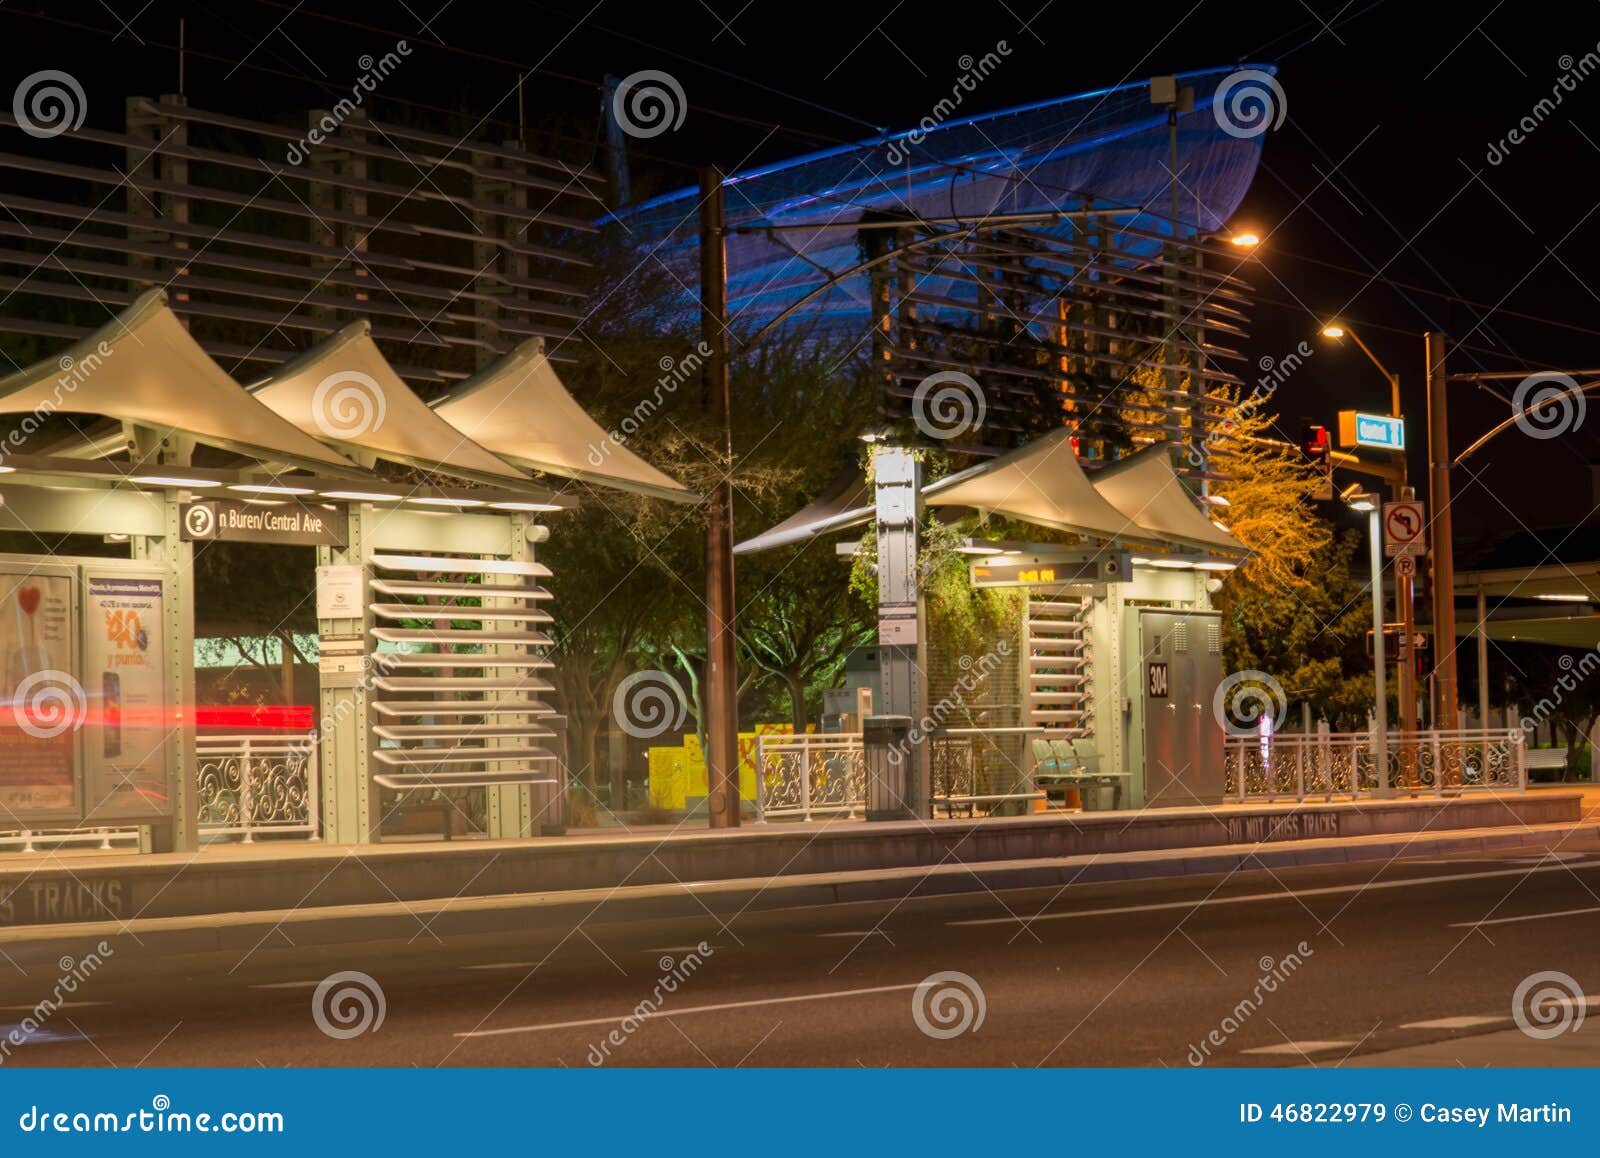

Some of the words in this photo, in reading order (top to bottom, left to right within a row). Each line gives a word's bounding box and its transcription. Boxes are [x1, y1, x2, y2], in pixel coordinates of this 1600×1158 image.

[229, 509, 300, 531] Buren/Central
[303, 514, 322, 533] Ave
[1150, 666, 1167, 695] 304
[1246, 817, 1264, 841] NOT
[1269, 815, 1298, 839] CROSS
[1303, 813, 1337, 836] TRACKS
[29, 880, 123, 918] TRACKS
